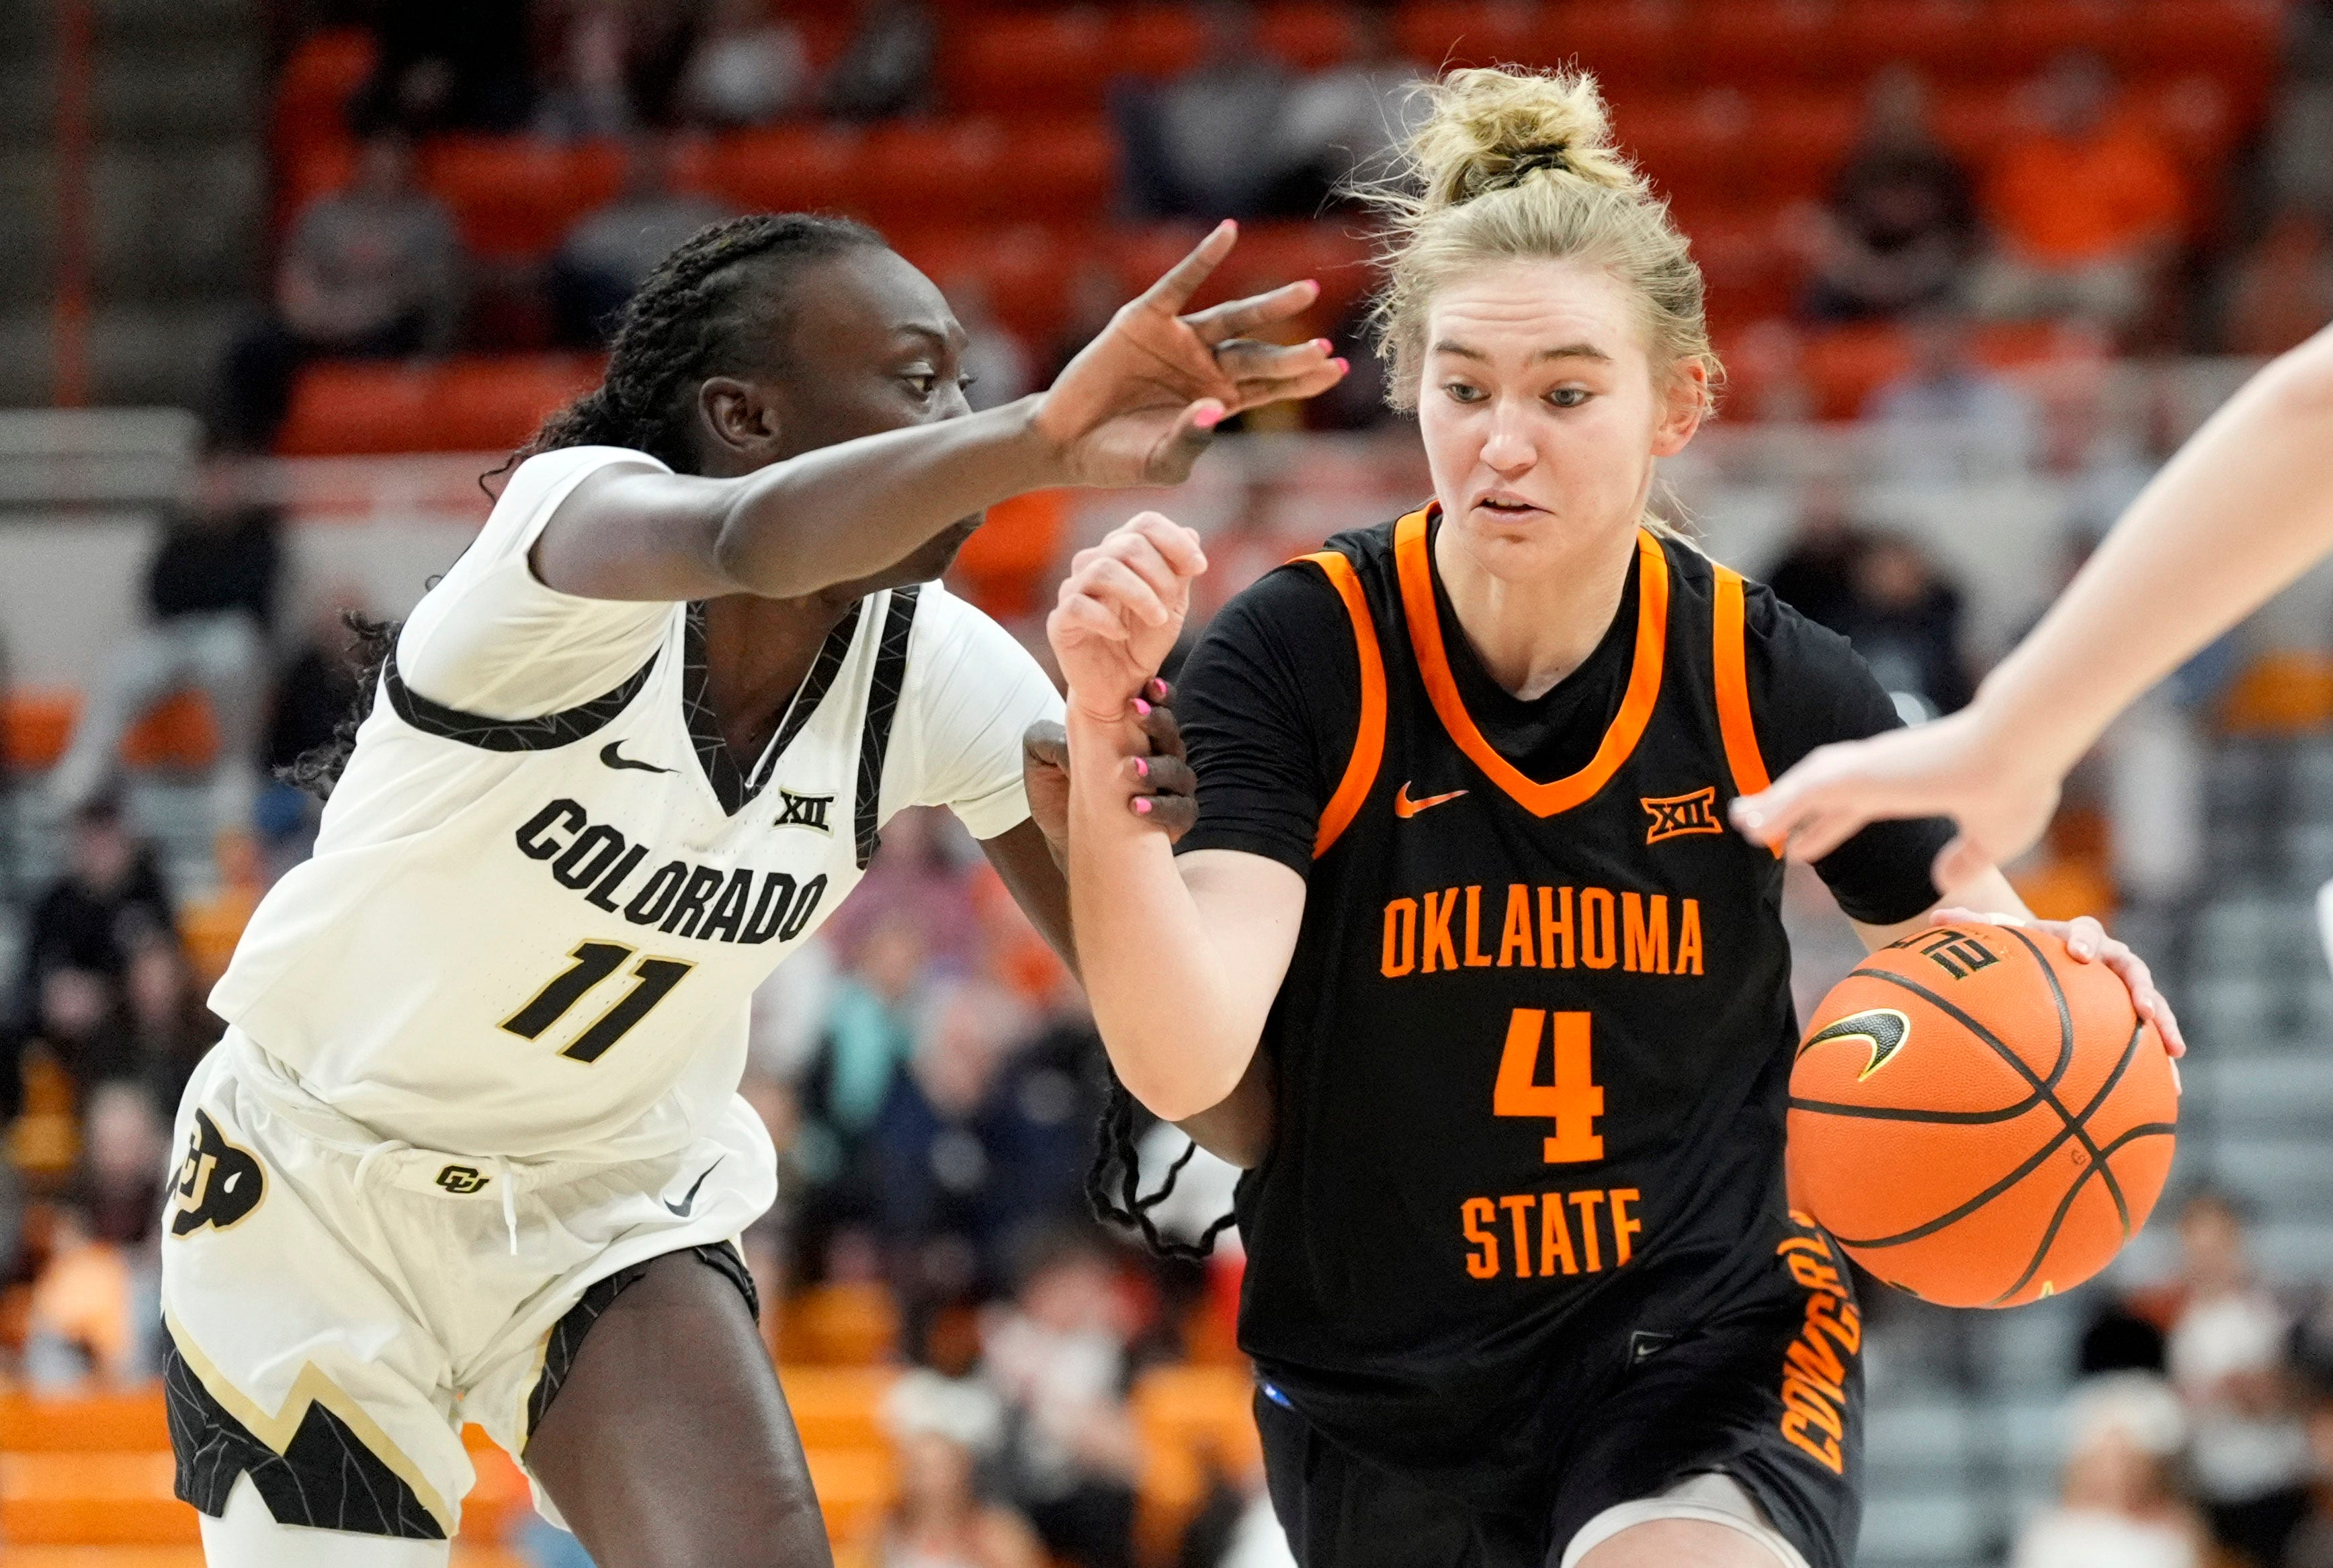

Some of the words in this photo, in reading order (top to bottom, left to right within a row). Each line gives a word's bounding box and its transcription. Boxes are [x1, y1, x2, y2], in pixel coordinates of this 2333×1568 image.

[773, 789, 835, 832] XII
[1644, 791, 1718, 839] XII
[516, 798, 827, 945] COLORADO
[1380, 884, 1705, 977] OKLAHOMA
[496, 939, 697, 1065] 11
[1493, 1008, 1605, 1164] 4
[1461, 1188, 1642, 1279] STATE
